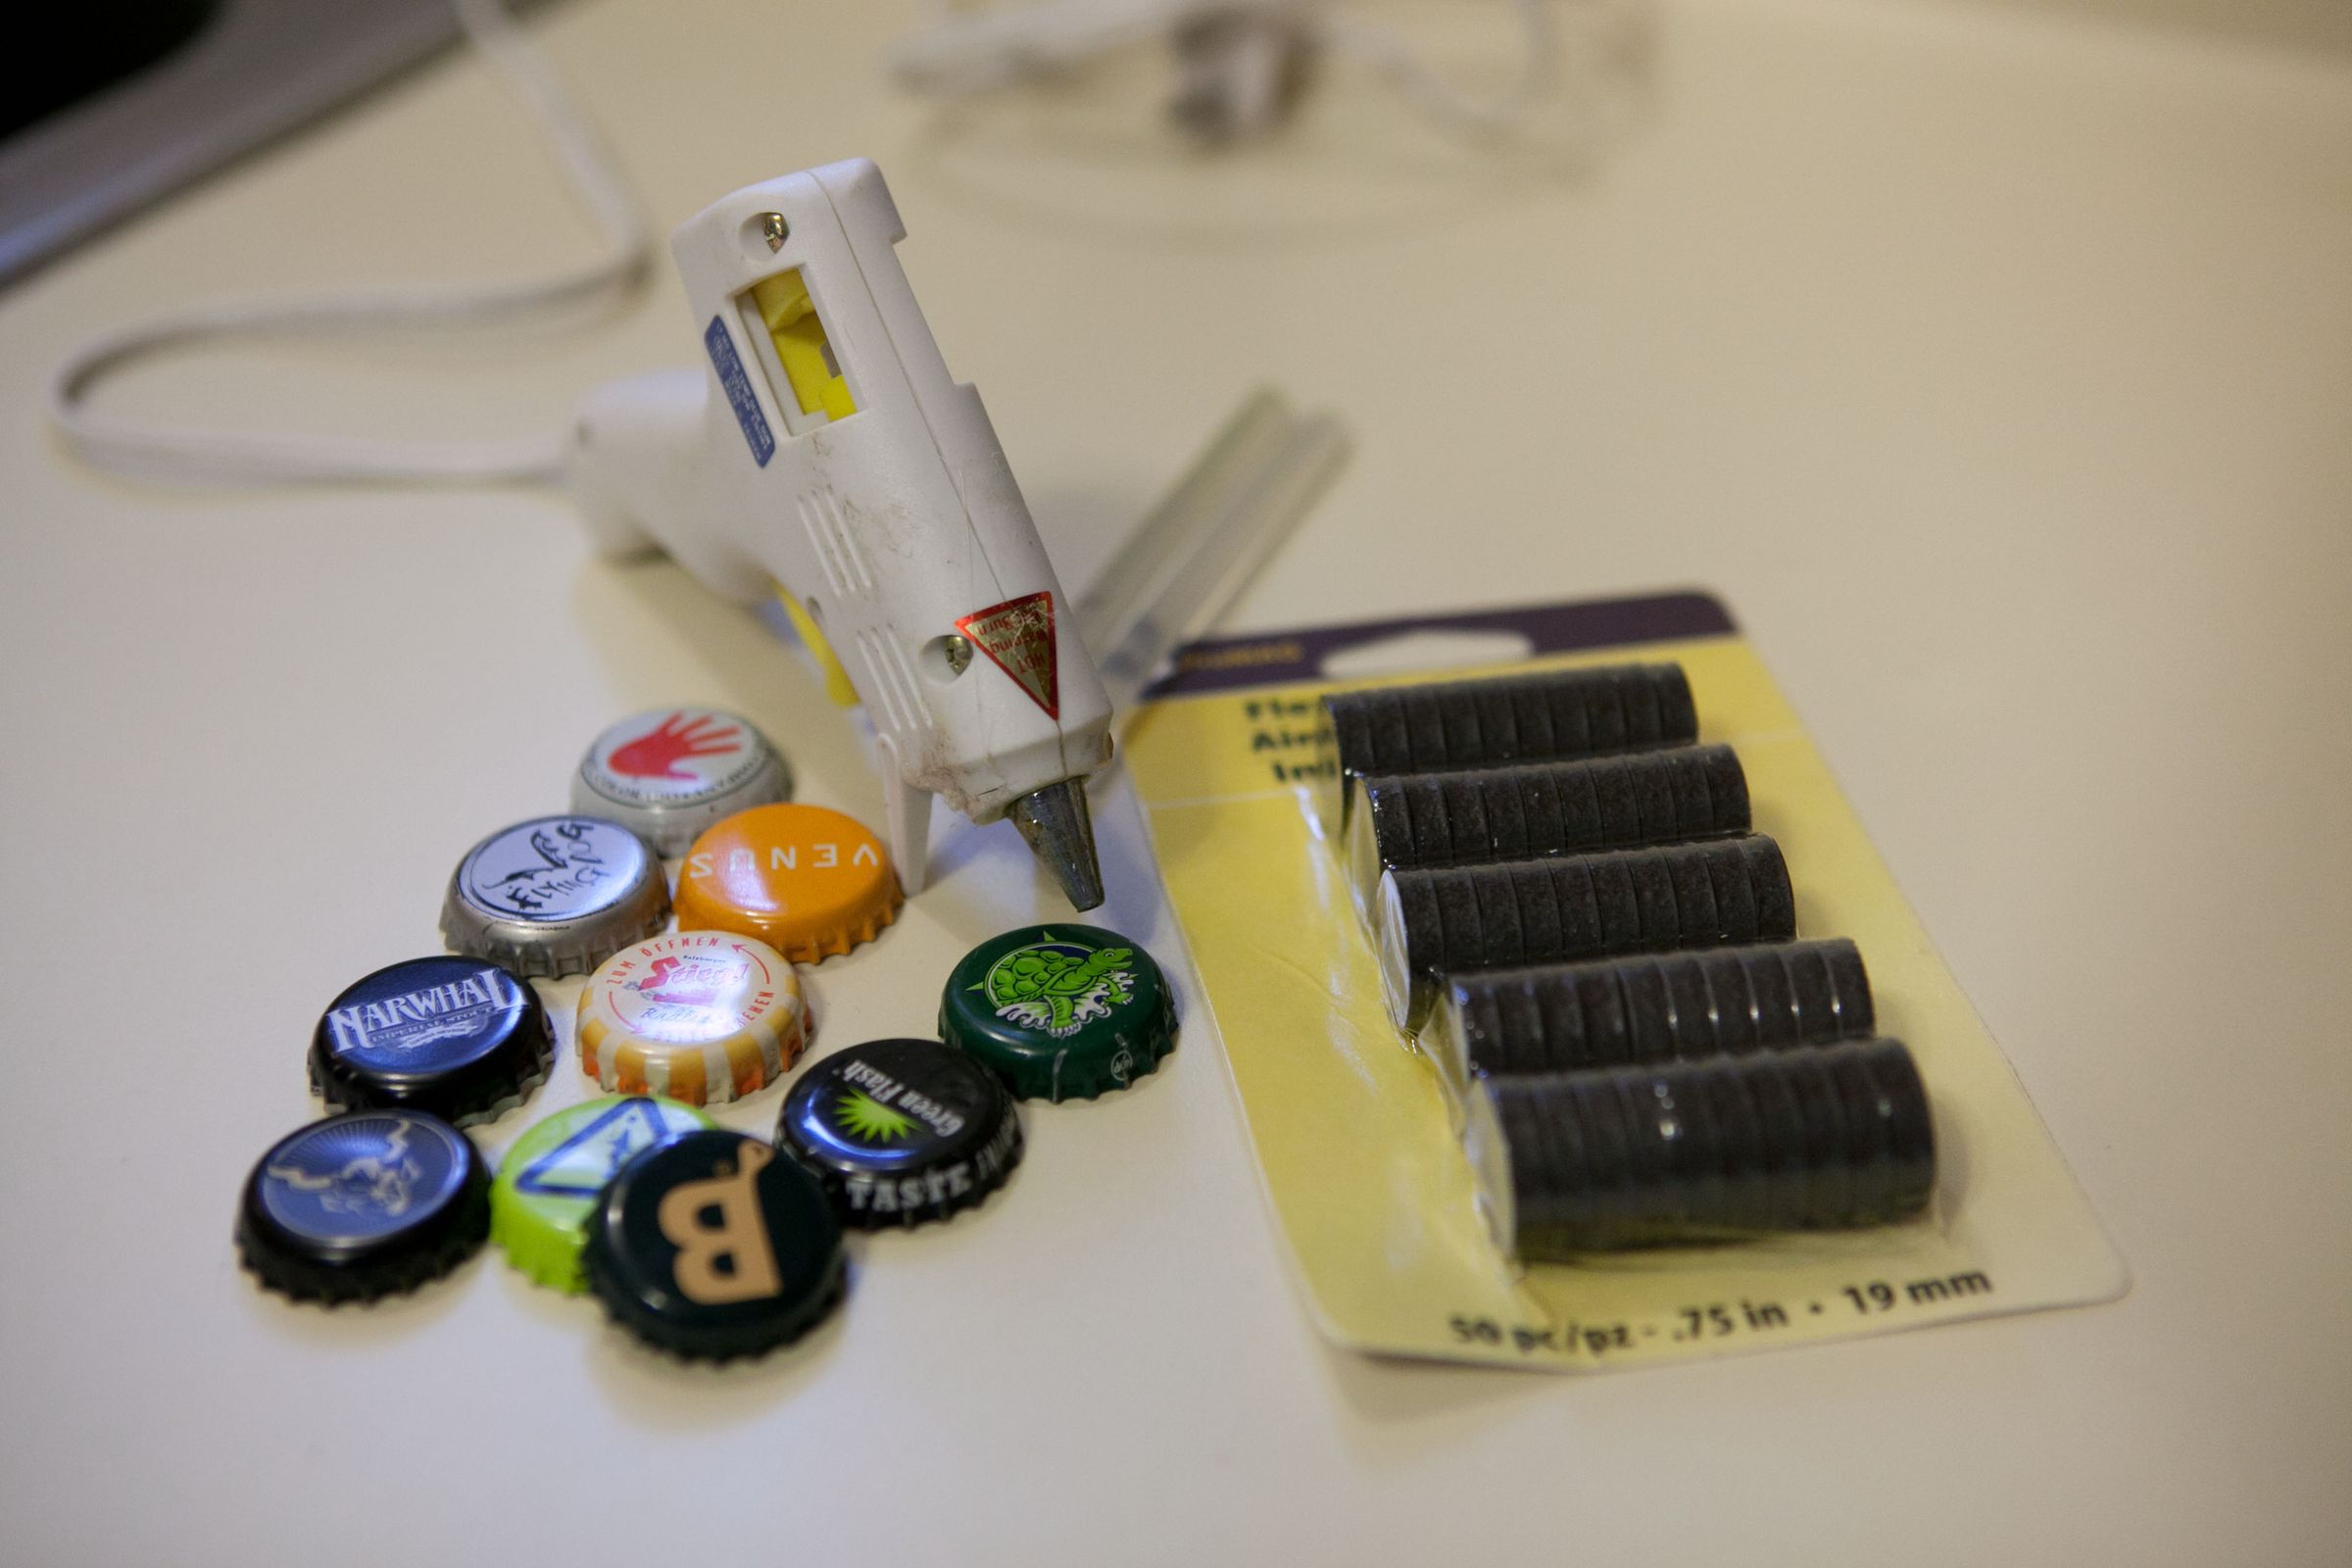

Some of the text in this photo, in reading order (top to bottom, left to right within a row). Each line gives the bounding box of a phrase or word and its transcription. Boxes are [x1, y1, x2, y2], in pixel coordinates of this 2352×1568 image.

[689, 844, 878, 879] VENUS
[607, 936, 720, 985] ZUM ÖFFNEN
[329, 967, 528, 1054] NARWHAL
[841, 1058, 906, 1104] Flash
[897, 1089, 965, 1139] Green
[844, 1159, 973, 1212] TASTE
[1448, 1311, 1502, 1346] 50
[1671, 1304, 1736, 1341] .75
[1740, 1298, 1792, 1331] in
[1843, 1283, 1895, 1314] 19
[1905, 1269, 1993, 1305] mm
